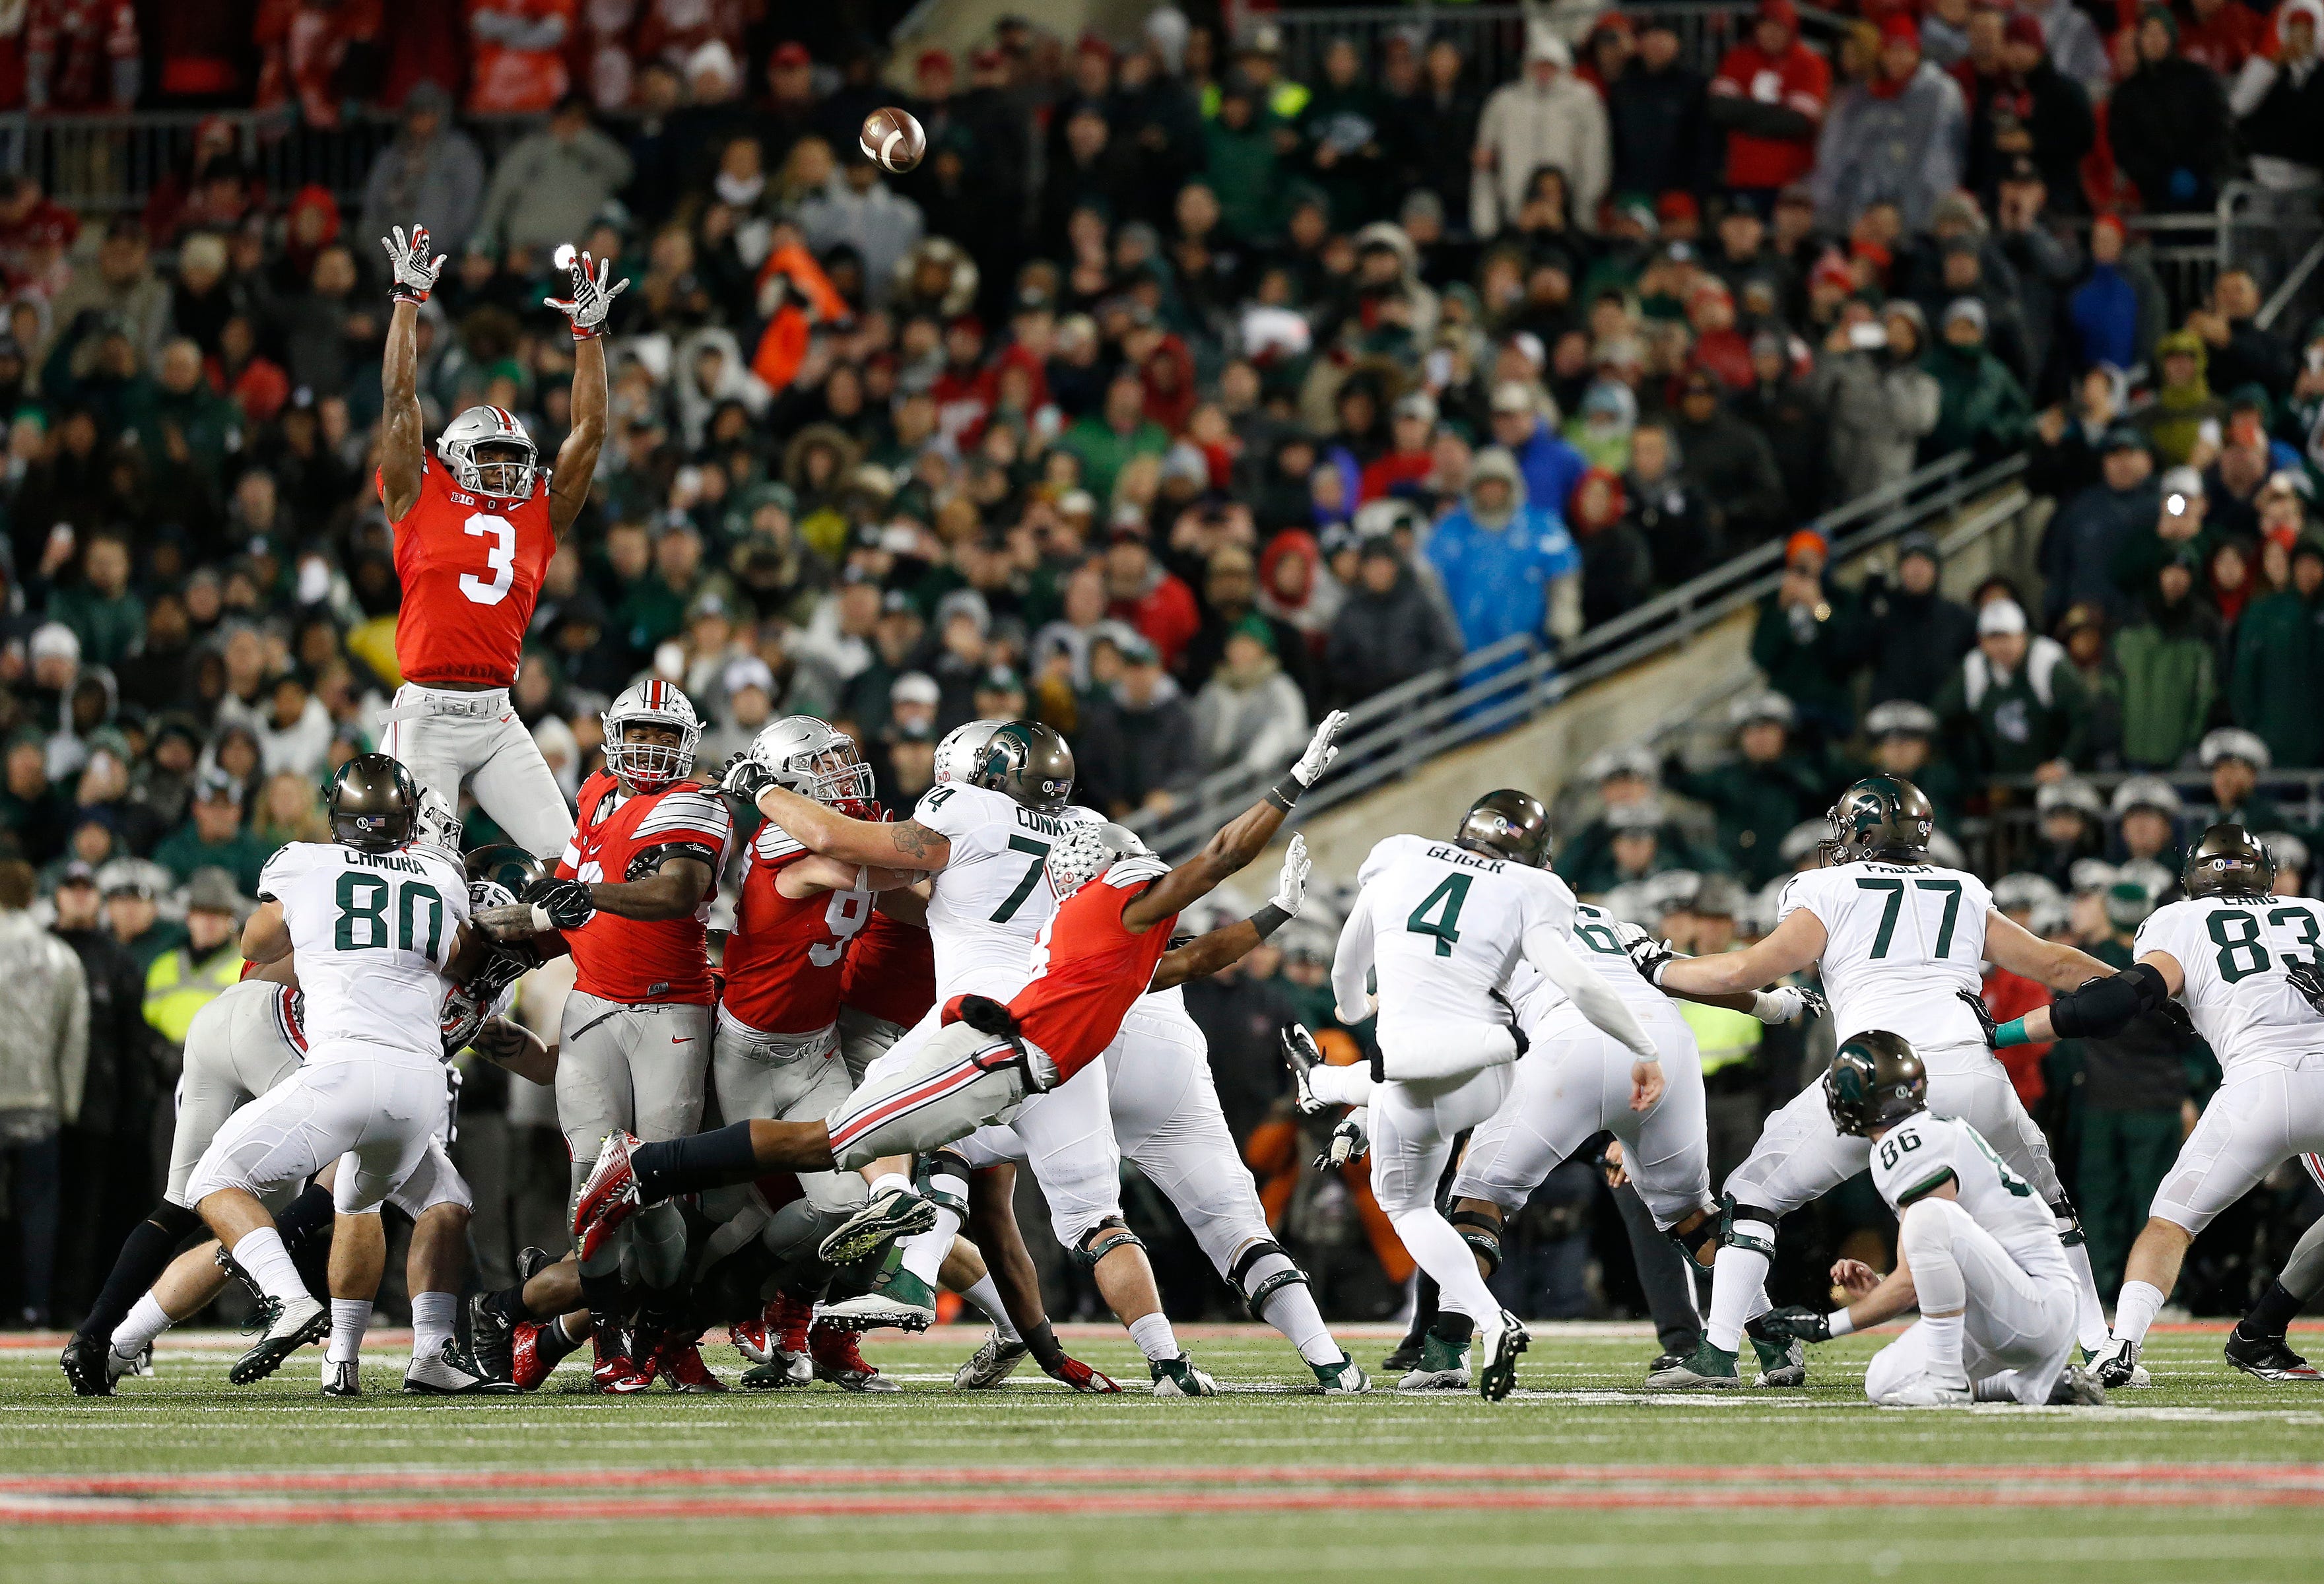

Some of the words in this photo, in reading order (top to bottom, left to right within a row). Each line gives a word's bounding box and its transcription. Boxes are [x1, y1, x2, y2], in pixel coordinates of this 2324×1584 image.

[458, 512, 516, 606] 3
[1426, 846, 1506, 874] GEIGER
[335, 871, 443, 964] 80
[1407, 872, 1474, 957] 4
[1855, 878, 1962, 959] 77
[2206, 906, 2324, 985] 83
[1880, 1127, 1922, 1171] 86
